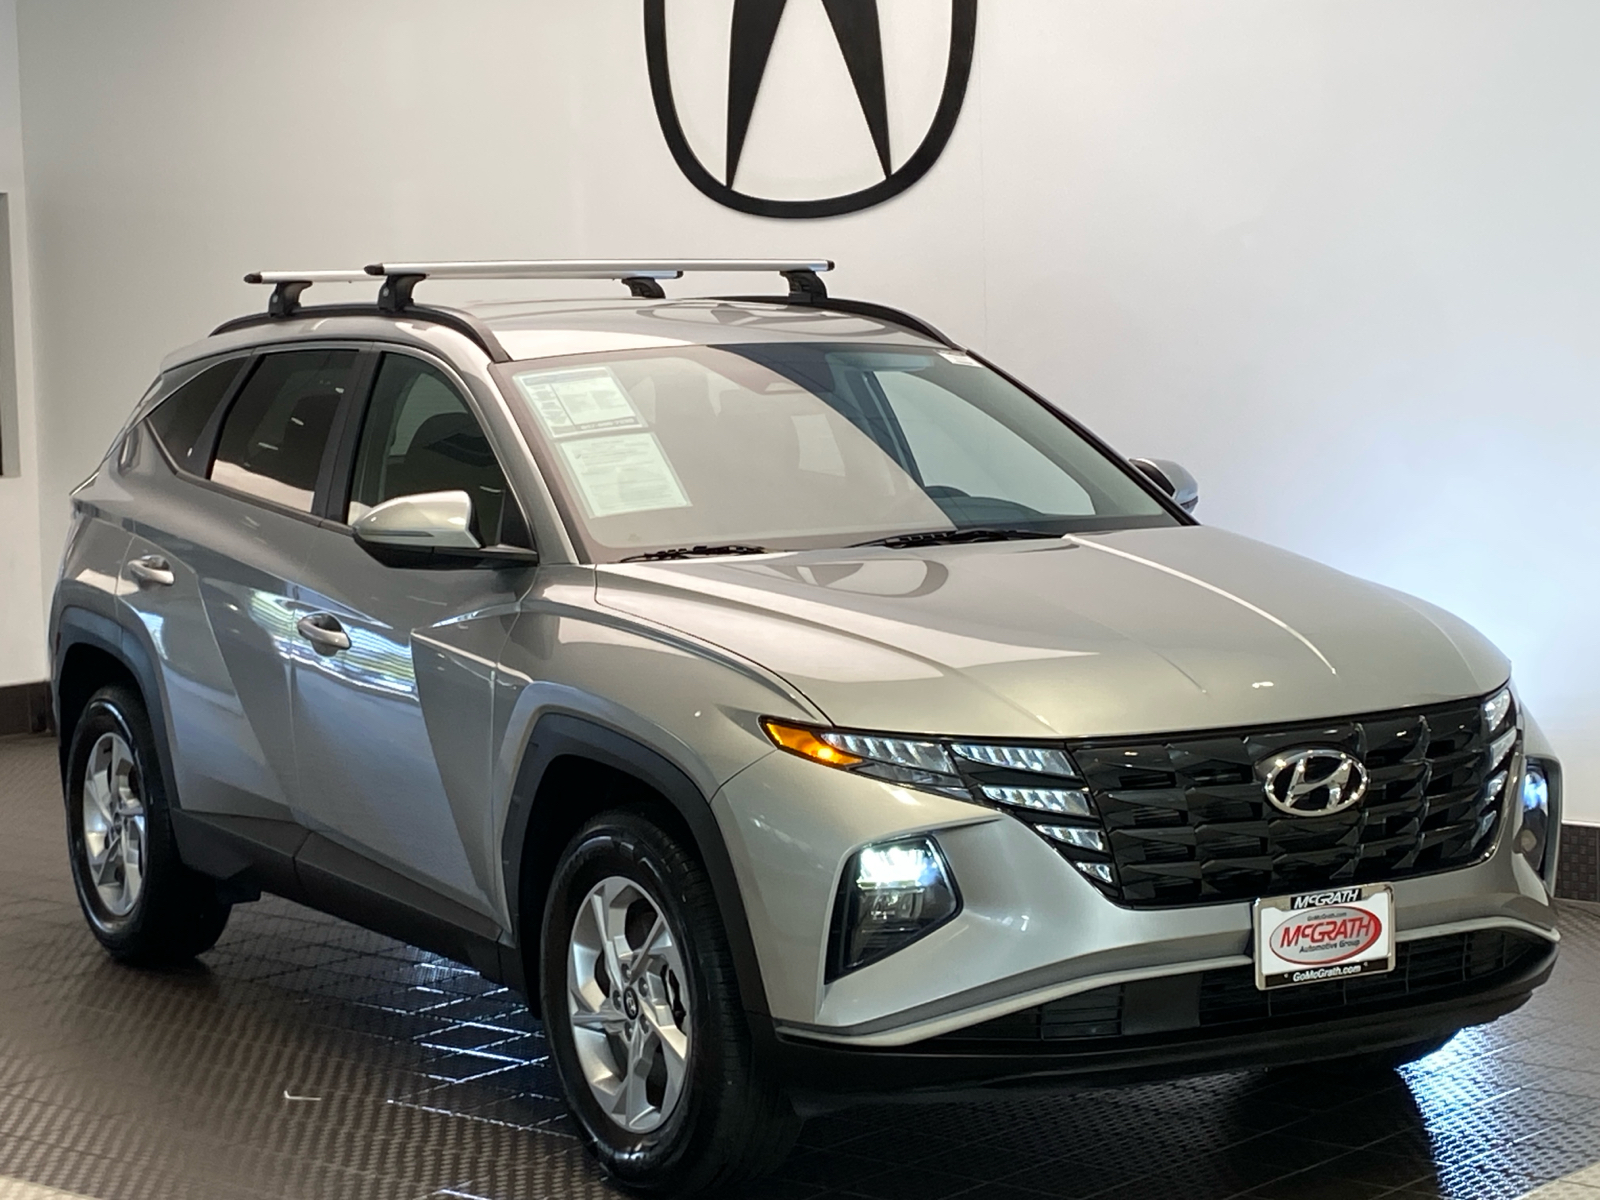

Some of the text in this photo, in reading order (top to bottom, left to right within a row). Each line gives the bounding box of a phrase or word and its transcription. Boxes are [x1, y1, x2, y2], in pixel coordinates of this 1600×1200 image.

[1299, 939, 1360, 953] Automotive Group
[1293, 965, 1361, 981] GoMcGrath.com
